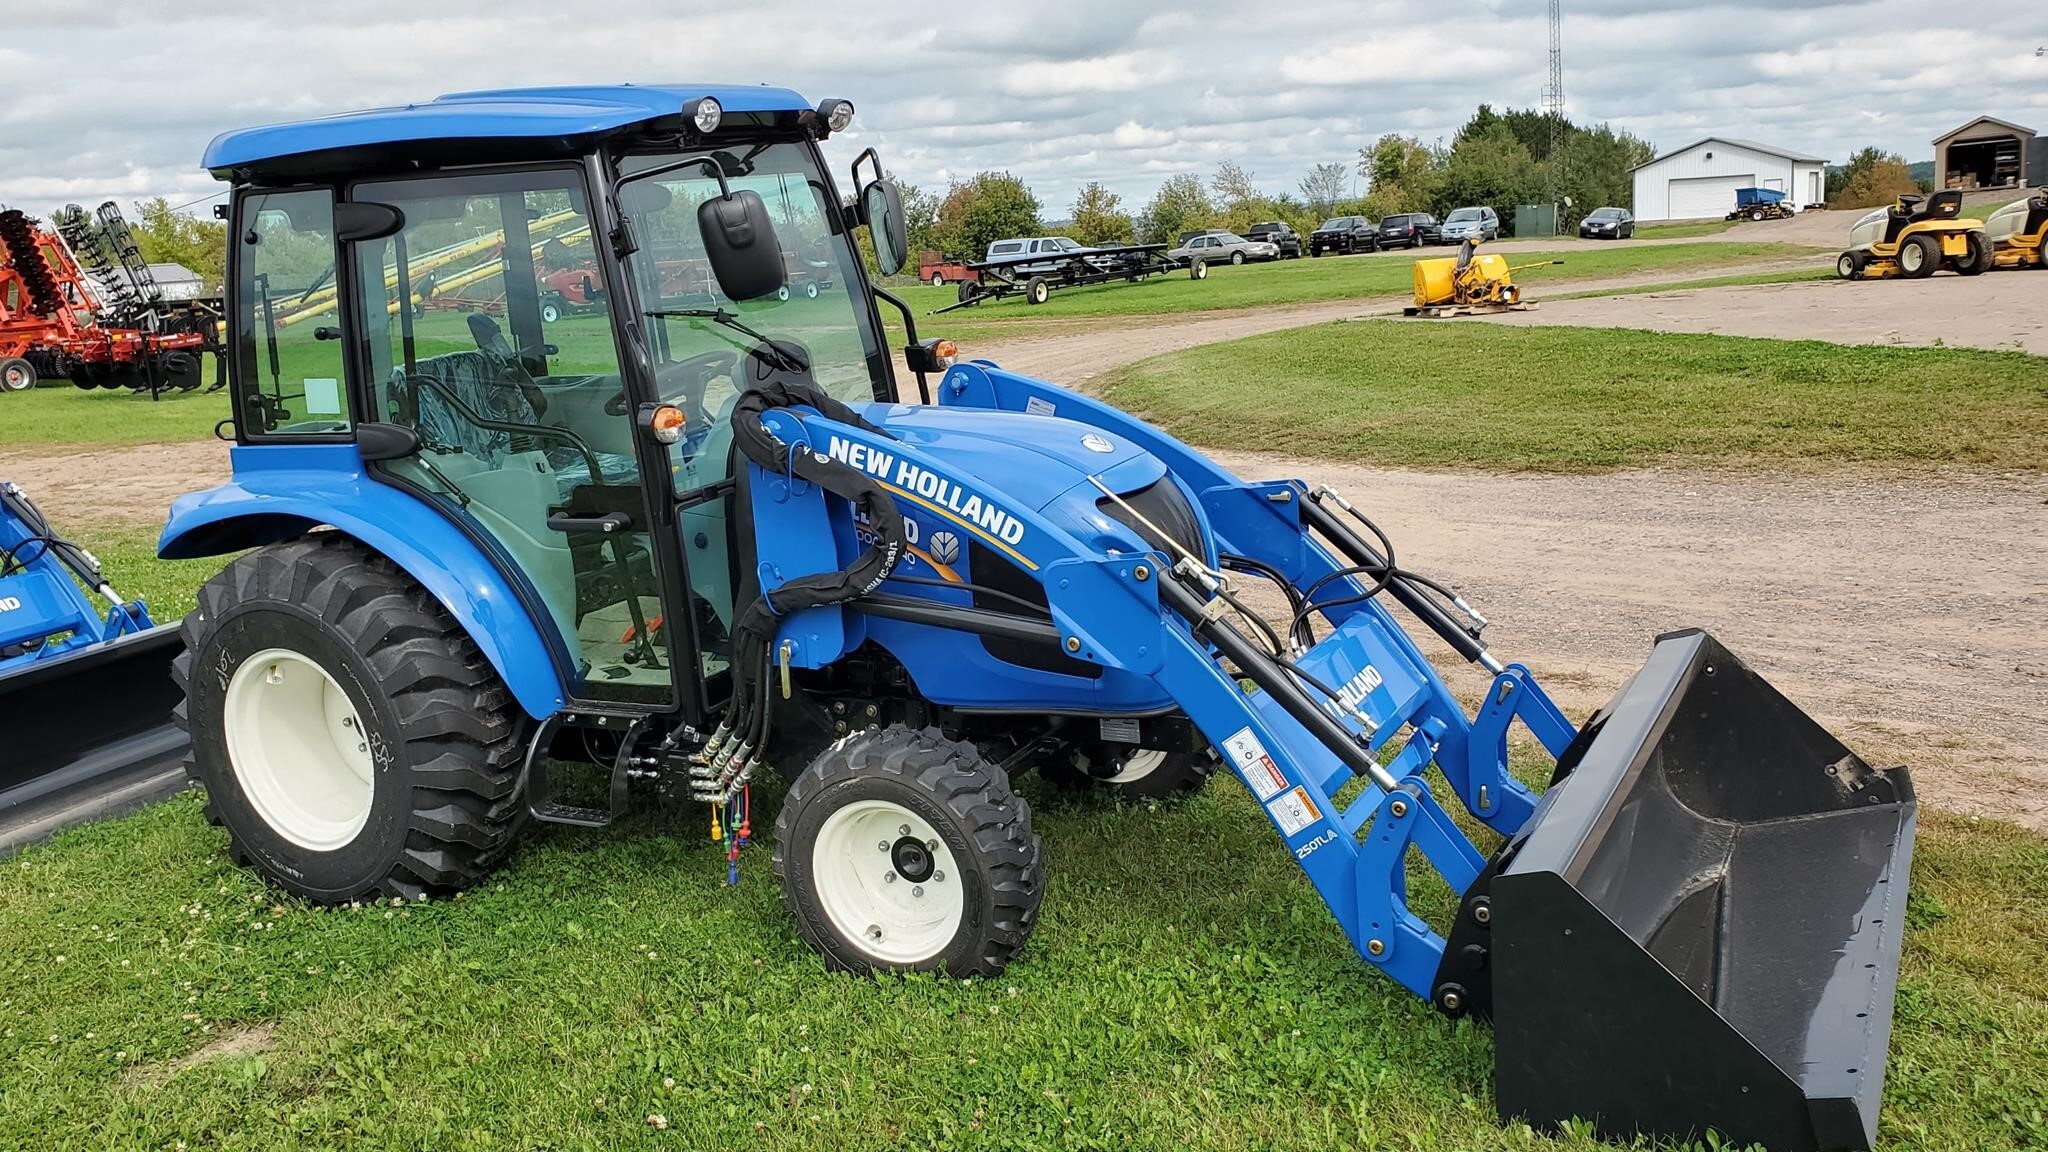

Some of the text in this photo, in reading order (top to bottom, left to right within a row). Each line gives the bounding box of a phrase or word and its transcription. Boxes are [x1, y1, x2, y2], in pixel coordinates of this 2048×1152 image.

[829, 435, 894, 479] NEW
[896, 460, 1024, 545] HOLLAND
[1267, 763, 1285, 787] DANGER
[1295, 829, 1338, 859] 250TLA
